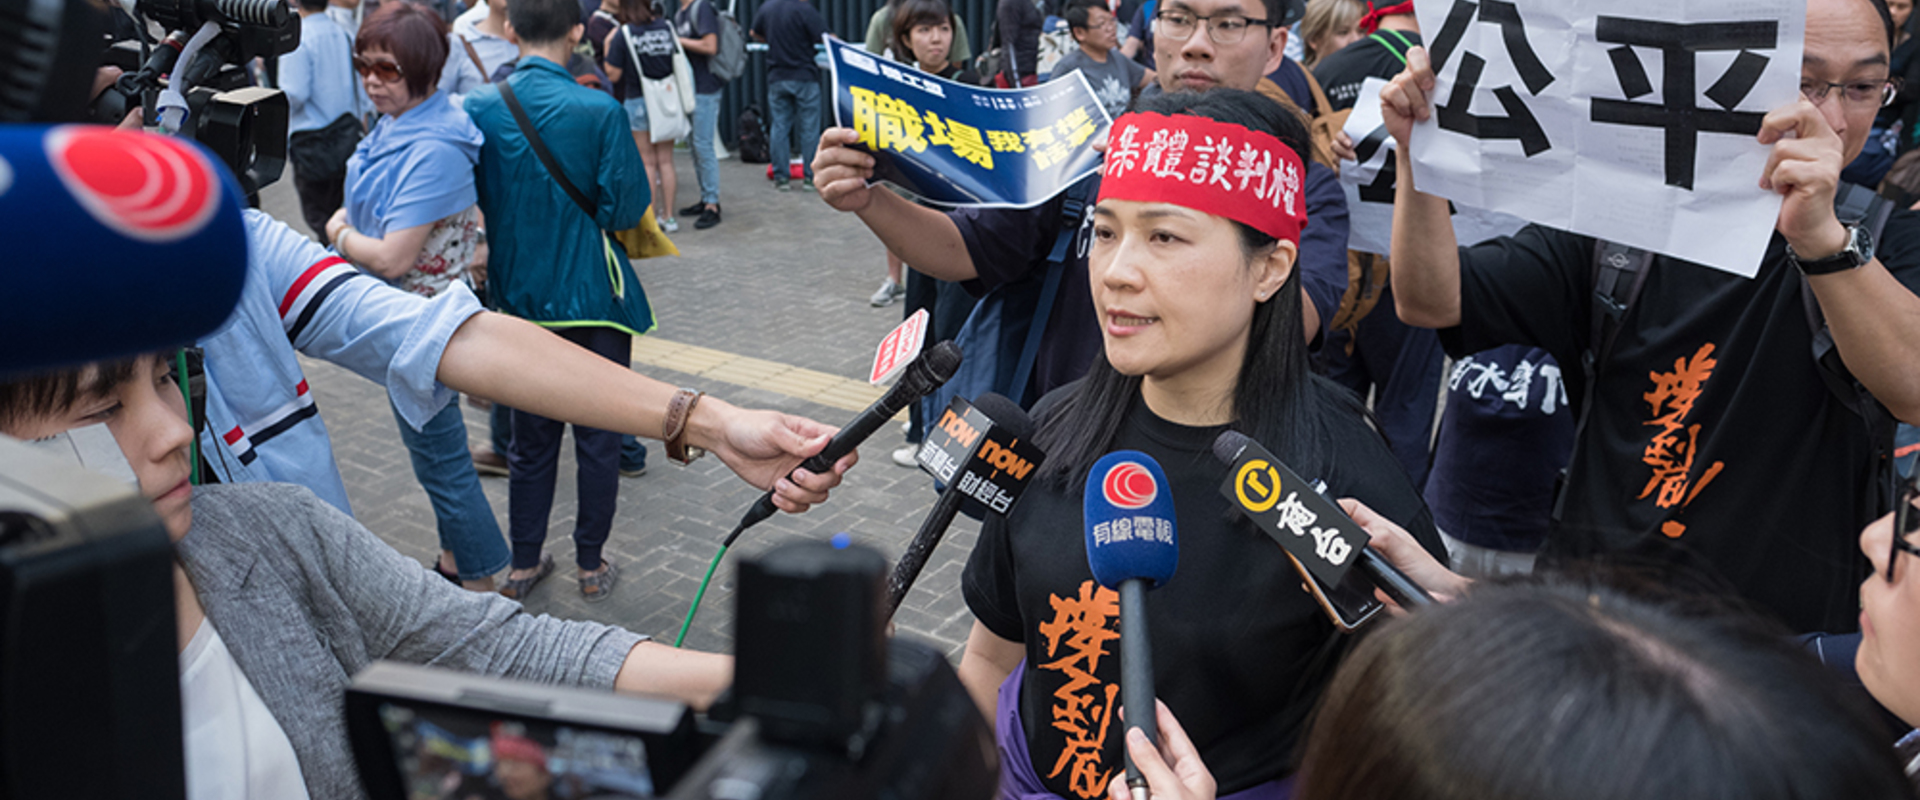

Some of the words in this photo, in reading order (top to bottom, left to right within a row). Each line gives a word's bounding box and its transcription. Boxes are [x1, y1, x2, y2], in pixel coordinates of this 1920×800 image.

[1429, 0, 1779, 190] 公平
[849, 86, 994, 170] 職場
[1105, 124, 1299, 216] 集體談判權
[938, 408, 980, 448] now
[977, 438, 1035, 480] now
[956, 470, 1014, 514] 財經台
[1092, 515, 1174, 547] 有線電視
[1276, 491, 1352, 566] 商台
